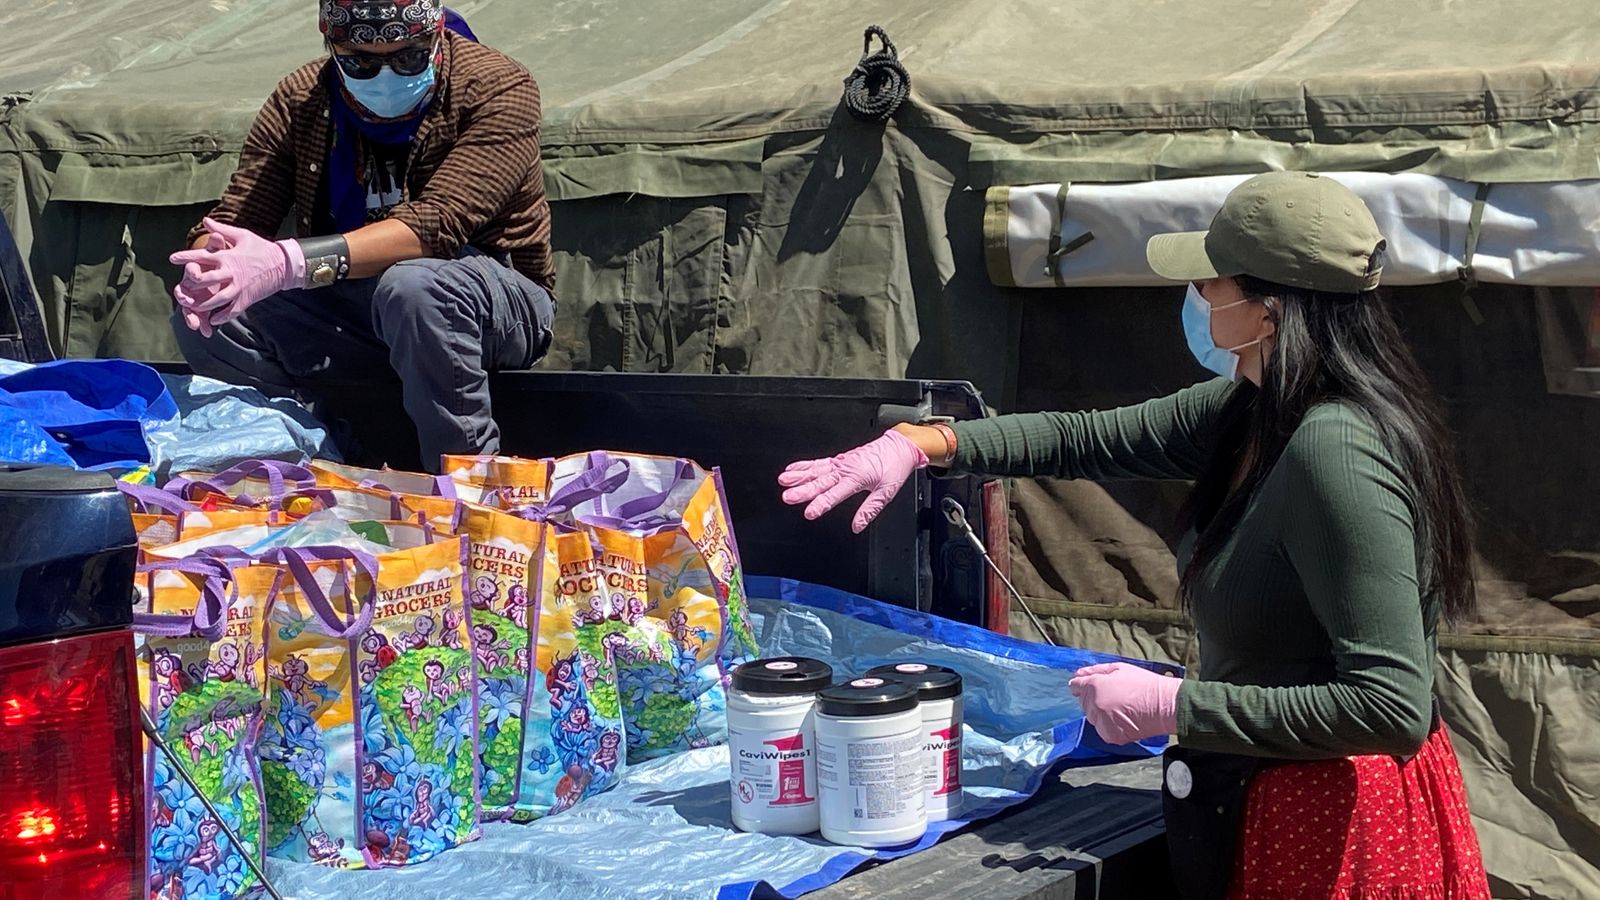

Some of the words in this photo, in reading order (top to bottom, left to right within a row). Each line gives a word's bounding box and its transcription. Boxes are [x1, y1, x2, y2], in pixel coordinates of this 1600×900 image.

[473, 543, 527, 565] TURAL
[473, 557, 525, 578] CERS
[380, 577, 452, 602] NATURAL
[374, 591, 452, 620] GROCERS
[739, 749, 811, 761] CaviWipes1
